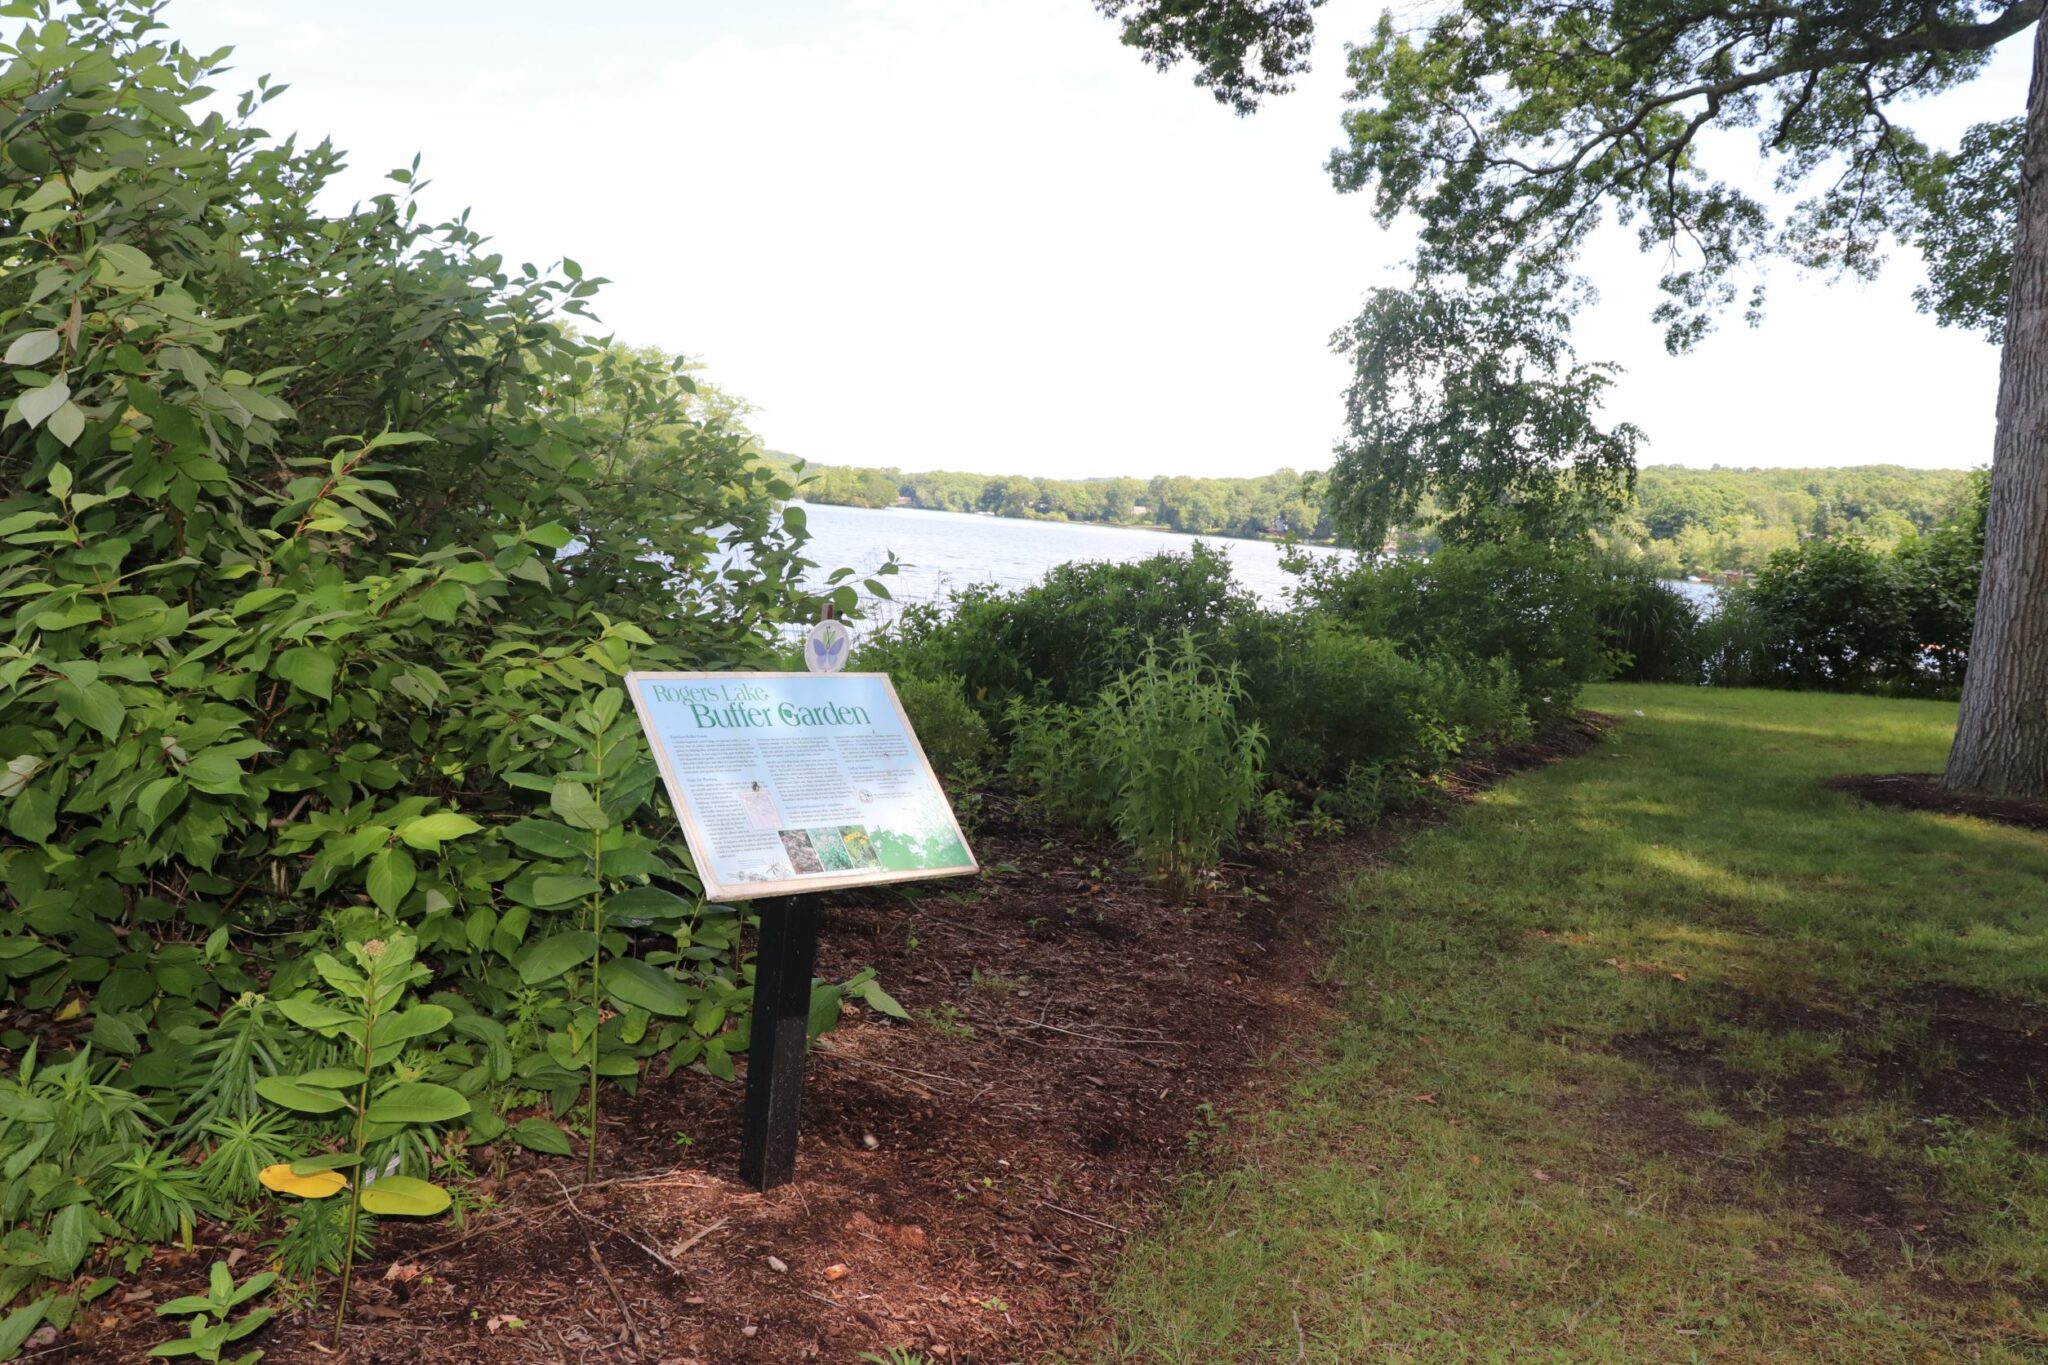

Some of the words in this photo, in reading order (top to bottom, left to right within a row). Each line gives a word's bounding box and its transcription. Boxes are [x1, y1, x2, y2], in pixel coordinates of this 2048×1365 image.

[652, 684, 719, 705] Rogers
[721, 684, 765, 701] Lake
[689, 702, 773, 728] Buffer
[778, 702, 871, 726] Garden
